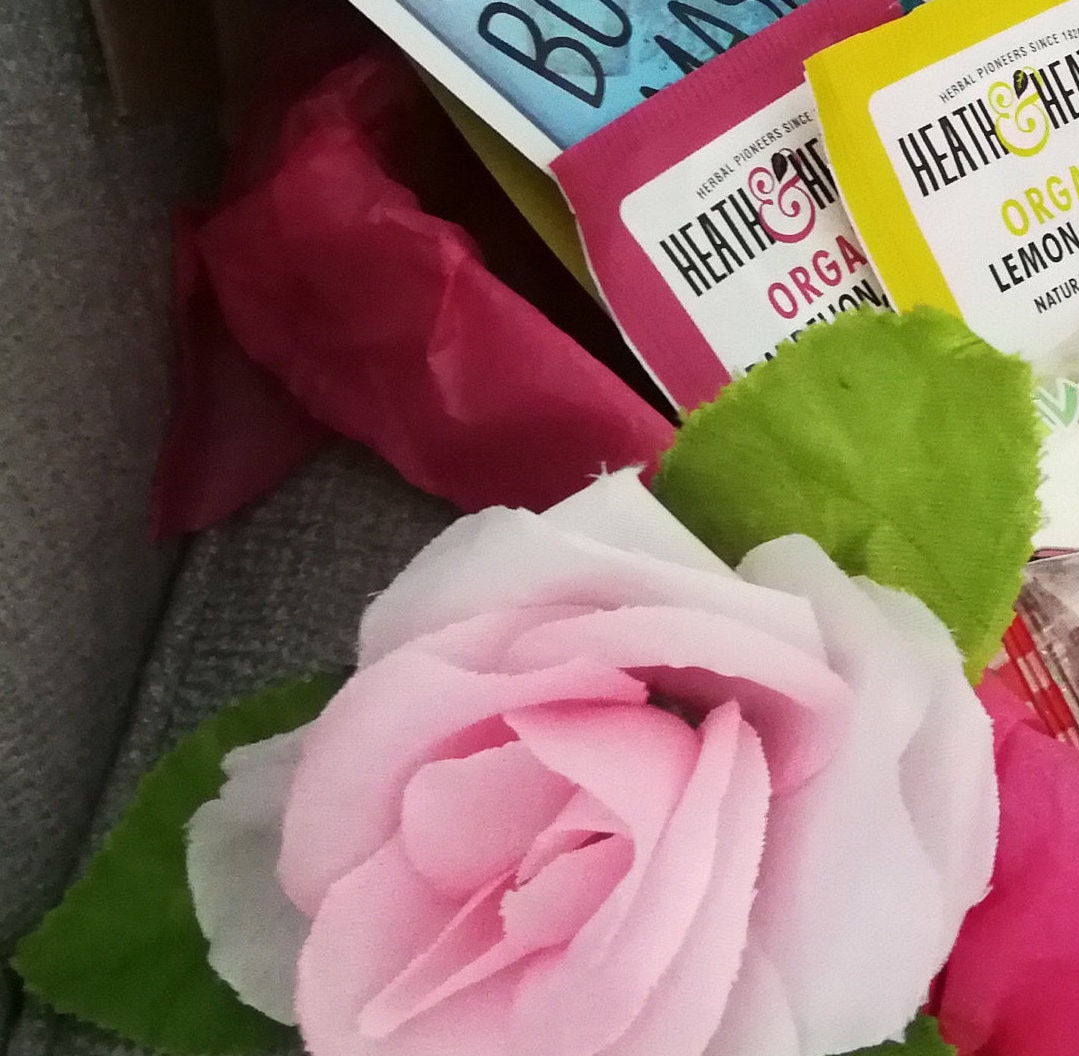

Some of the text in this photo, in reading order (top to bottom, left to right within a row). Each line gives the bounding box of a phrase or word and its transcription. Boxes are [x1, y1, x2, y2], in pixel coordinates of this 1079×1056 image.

[939, 76, 976, 104] HERBAL
[976, 46, 1028, 79] PIONEERS
[1029, 33, 1060, 54] SINCE
[696, 110, 813, 200] HERBAL PIONEERS SINCE
[898, 97, 1010, 198] HEATH
[659, 187, 776, 297] HEATH
[768, 234, 868, 320] ORGA
